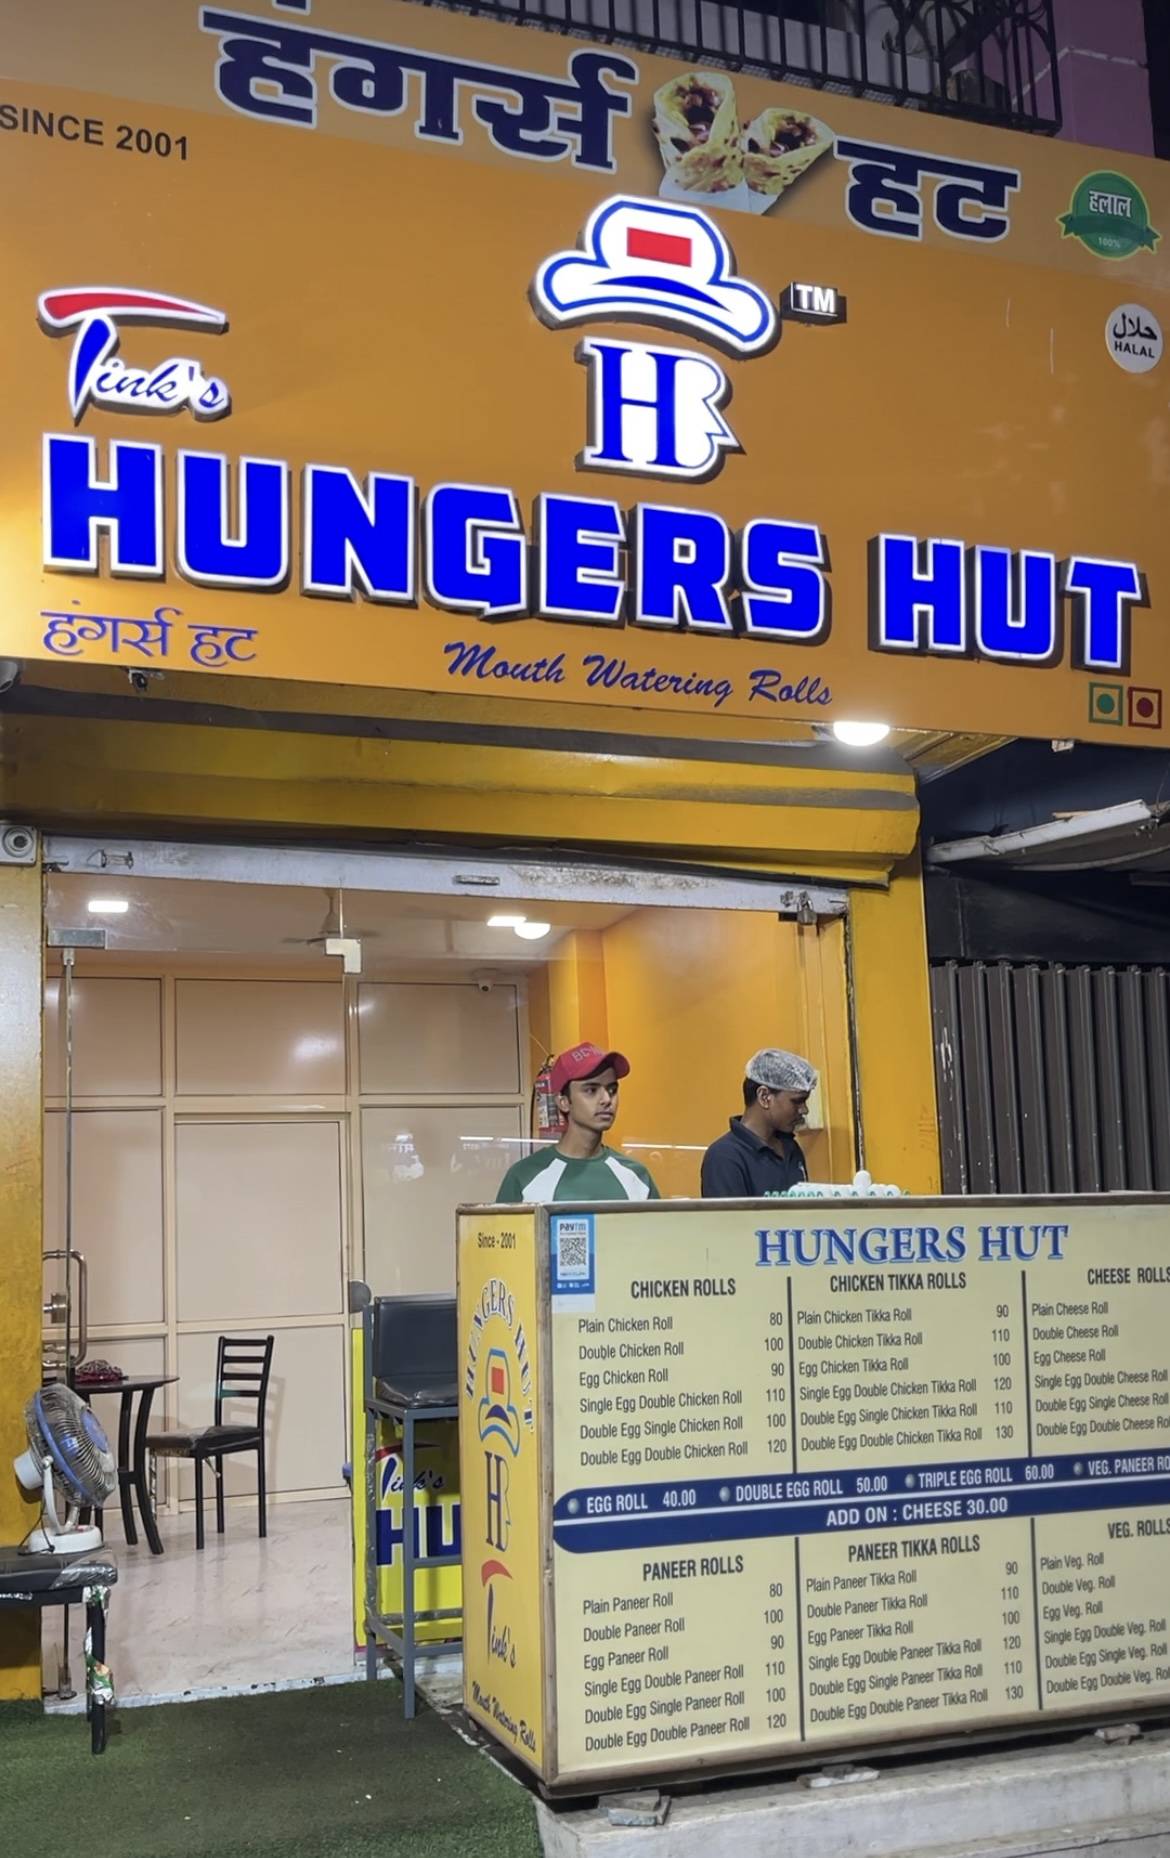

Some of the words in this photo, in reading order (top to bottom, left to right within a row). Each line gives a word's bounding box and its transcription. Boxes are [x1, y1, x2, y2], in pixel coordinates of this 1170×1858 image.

[0, 103, 105, 147] SINCE
[115, 124, 190, 161] 2001
[833, 135, 1021, 243] हट
[1089, 189, 1133, 218] हलाल
[1099, 236, 1121, 249] 100%
[795, 284, 836, 313] TM
[1112, 312, 1158, 341] حلال
[39, 287, 229, 417] Tink's
[1114, 340, 1156, 359] HALAL
[42, 433, 828, 639] HUNGERS
[876, 533, 1143, 670] HUT
[40, 600, 183, 657] हंगर्स
[187, 625, 259, 668] हट
[444, 641, 564, 684] Mouth
[583, 654, 734, 707] Watering
[748, 669, 832, 706] Rolls
[477, 1232, 495, 1249] Since
[501, 1233, 516, 1249] 2001
[755, 1225, 967, 1266] HUNGERS
[977, 1225, 1069, 1261] HUT
[830, 1273, 884, 1293] CHICKEN
[887, 1273, 924, 1290] TIKKA
[927, 1271, 967, 1289] ROLLS
[1087, 1267, 1131, 1285] CHEESE
[630, 1279, 689, 1299] CHICKEN
[693, 1277, 736, 1296] ROLLS
[769, 1311, 783, 1326] 80
[796, 1310, 821, 1325] Plain
[823, 1309, 863, 1324] Chicken
[864, 1308, 891, 1322] Tikka
[892, 1307, 912, 1321] Roll
[996, 1304, 1009, 1318] 90
[1031, 1302, 1054, 1316] Plain
[1055, 1302, 1089, 1316] Cheese
[1091, 1301, 1108, 1314] Roll
[578, 1318, 605, 1333] Plain
[607, 1317, 650, 1333] Chicken
[652, 1316, 673, 1331] Roll
[1032, 1326, 1064, 1340] Double
[1066, 1325, 1100, 1339] Cheese
[1101, 1324, 1119, 1338] Roll
[764, 1336, 784, 1351] 100
[797, 1335, 832, 1350] Double
[834, 1334, 874, 1349] Chicken
[875, 1332, 902, 1347] Tikka
[903, 1331, 923, 1346] Roll
[991, 1328, 1010, 1342] 110
[578, 1344, 616, 1360] Double
[618, 1342, 661, 1358] Chicken
[663, 1341, 684, 1356] Roll
[992, 1352, 1011, 1366] 100
[770, 1362, 785, 1377] 90
[798, 1361, 818, 1378] Egg
[820, 1359, 860, 1375] Chicken
[861, 1358, 888, 1372] Tikka
[889, 1357, 909, 1371] Roll
[579, 1371, 600, 1389] Egg
[602, 1369, 645, 1385] Chicken
[648, 1367, 668, 1383] Roll
[579, 1397, 613, 1415] Single
[615, 1396, 636, 1413] Egg
[638, 1393, 676, 1409] Double
[678, 1391, 720, 1407] Chicken
[722, 1389, 742, 1405] Roll
[765, 1387, 785, 1402] 110
[580, 1423, 618, 1439] Double
[620, 1422, 641, 1439] Egg
[644, 1419, 676, 1437] Single
[679, 1417, 720, 1433] Chicken
[723, 1415, 743, 1430] Roll
[766, 1412, 786, 1428] 100
[580, 1449, 618, 1466] Double
[621, 1448, 642, 1466] Egg
[644, 1445, 681, 1462] Double
[683, 1443, 725, 1459] Chicken
[727, 1440, 748, 1456] Roll
[767, 1438, 787, 1453] 120
[917, 1471, 957, 1489] TRIPLE
[959, 1470, 982, 1486] EGG
[984, 1468, 1013, 1484] ROLL
[1024, 1465, 1054, 1481] 60.00
[1087, 1460, 1112, 1476] VEG.
[1114, 1458, 1154, 1474] PANEER
[735, 1482, 783, 1502] DOUBLE
[786, 1482, 810, 1498] EGG
[813, 1480, 843, 1496] ROLL
[856, 1477, 888, 1493] 50.00
[586, 1495, 612, 1514] EGG
[615, 1493, 648, 1511] ROLL
[662, 1488, 696, 1507] 40.00
[826, 1508, 860, 1526] ADD
[865, 1505, 887, 1523] ON
[902, 1500, 962, 1520] CHEESE
[966, 1496, 1008, 1515] 30.00
[1107, 1521, 1134, 1539] VEG.
[848, 1541, 898, 1562] PANEER
[900, 1538, 938, 1557] TIKKA
[940, 1534, 980, 1554] ROLLS
[643, 1559, 697, 1581] PANEER
[700, 1554, 744, 1576] ROLLS
[1005, 1561, 1018, 1576] 90
[1040, 1556, 1063, 1570] Plain
[1063, 1554, 1084, 1570] Veg.
[1086, 1551, 1104, 1566] Roll
[769, 1582, 783, 1598] 80
[806, 1577, 831, 1593] Plain
[833, 1575, 868, 1590] Paneer
[869, 1571, 896, 1586] Tikka
[897, 1569, 917, 1584] Roll
[1041, 1579, 1074, 1595] Double
[1075, 1578, 1095, 1593] Veg.
[1097, 1575, 1116, 1589] Roll
[1001, 1585, 1019, 1600] 110
[583, 1599, 610, 1615] Plain
[612, 1596, 650, 1612] Paneer
[652, 1591, 673, 1607] Roll
[806, 1602, 842, 1619] Double
[844, 1600, 879, 1615] Paneer
[880, 1595, 907, 1611] Tikka
[908, 1593, 928, 1608] Roll
[763, 1608, 784, 1624] 100
[583, 1624, 621, 1642] Double
[624, 1622, 662, 1637] Paneer
[664, 1617, 685, 1633] Roll
[770, 1634, 784, 1650] 90
[583, 1654, 605, 1672] Egg
[607, 1650, 645, 1666] Paneer
[647, 1645, 669, 1662] Roll
[765, 1660, 785, 1676] 110
[584, 1679, 618, 1698] Single
[620, 1676, 642, 1694] Egg
[644, 1671, 682, 1689] Double
[684, 1669, 721, 1684] Paneer
[723, 1663, 744, 1680] Roll
